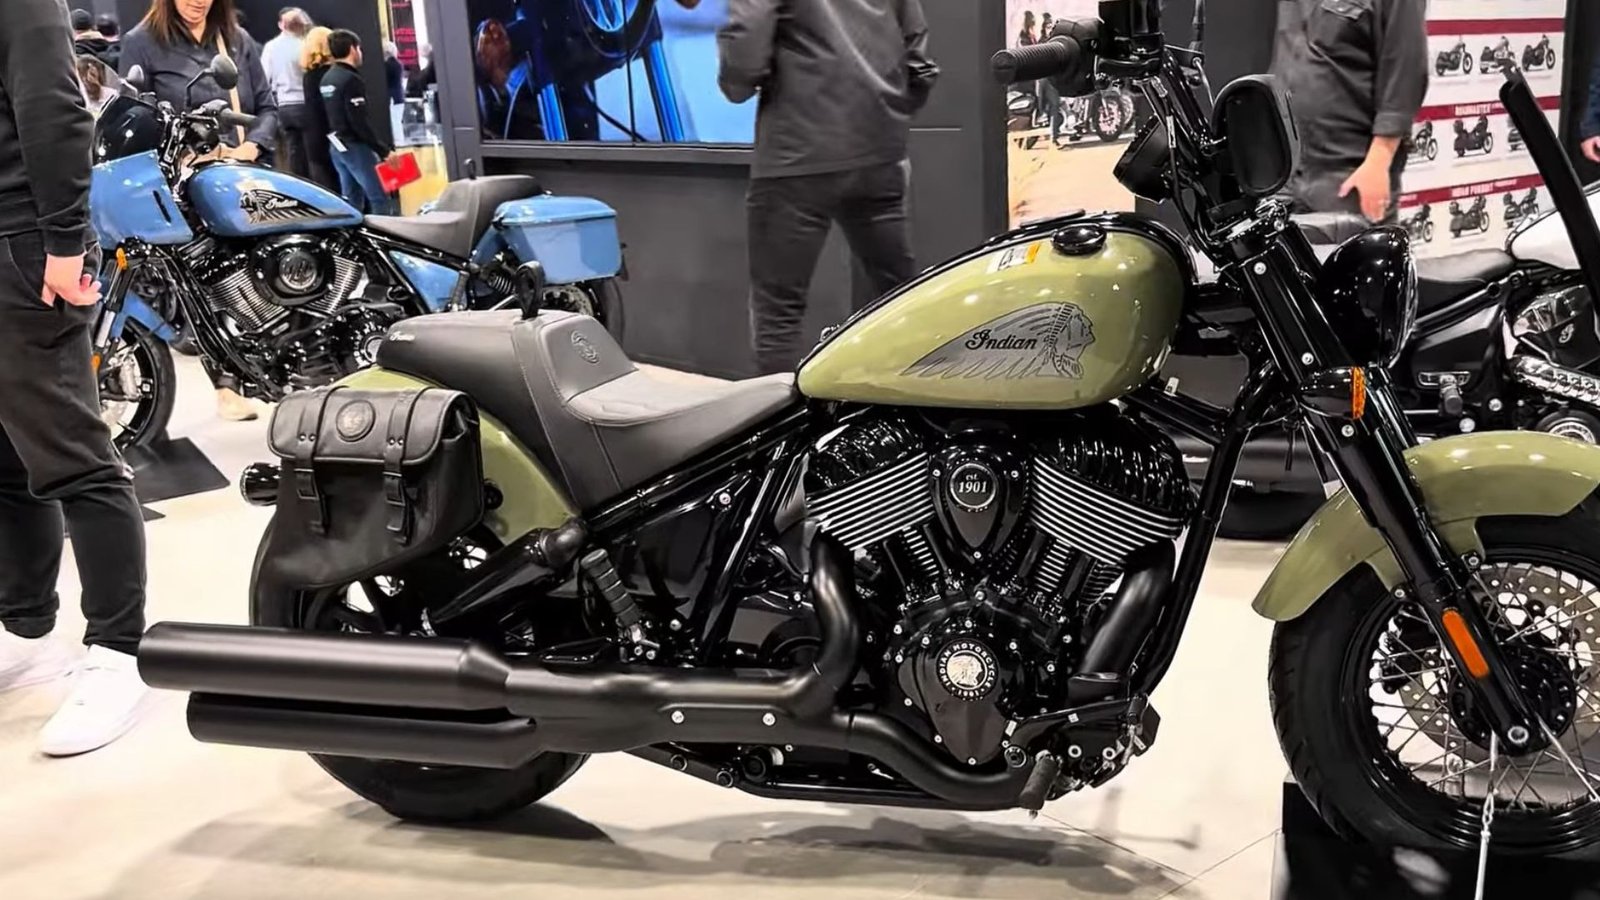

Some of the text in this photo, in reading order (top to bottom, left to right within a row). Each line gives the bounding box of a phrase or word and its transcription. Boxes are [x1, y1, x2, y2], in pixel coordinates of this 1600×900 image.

[965, 329, 1037, 350] Indian
[959, 481, 987, 493] 1901
[939, 642, 995, 688] INDIAN MOTORCYCLE
